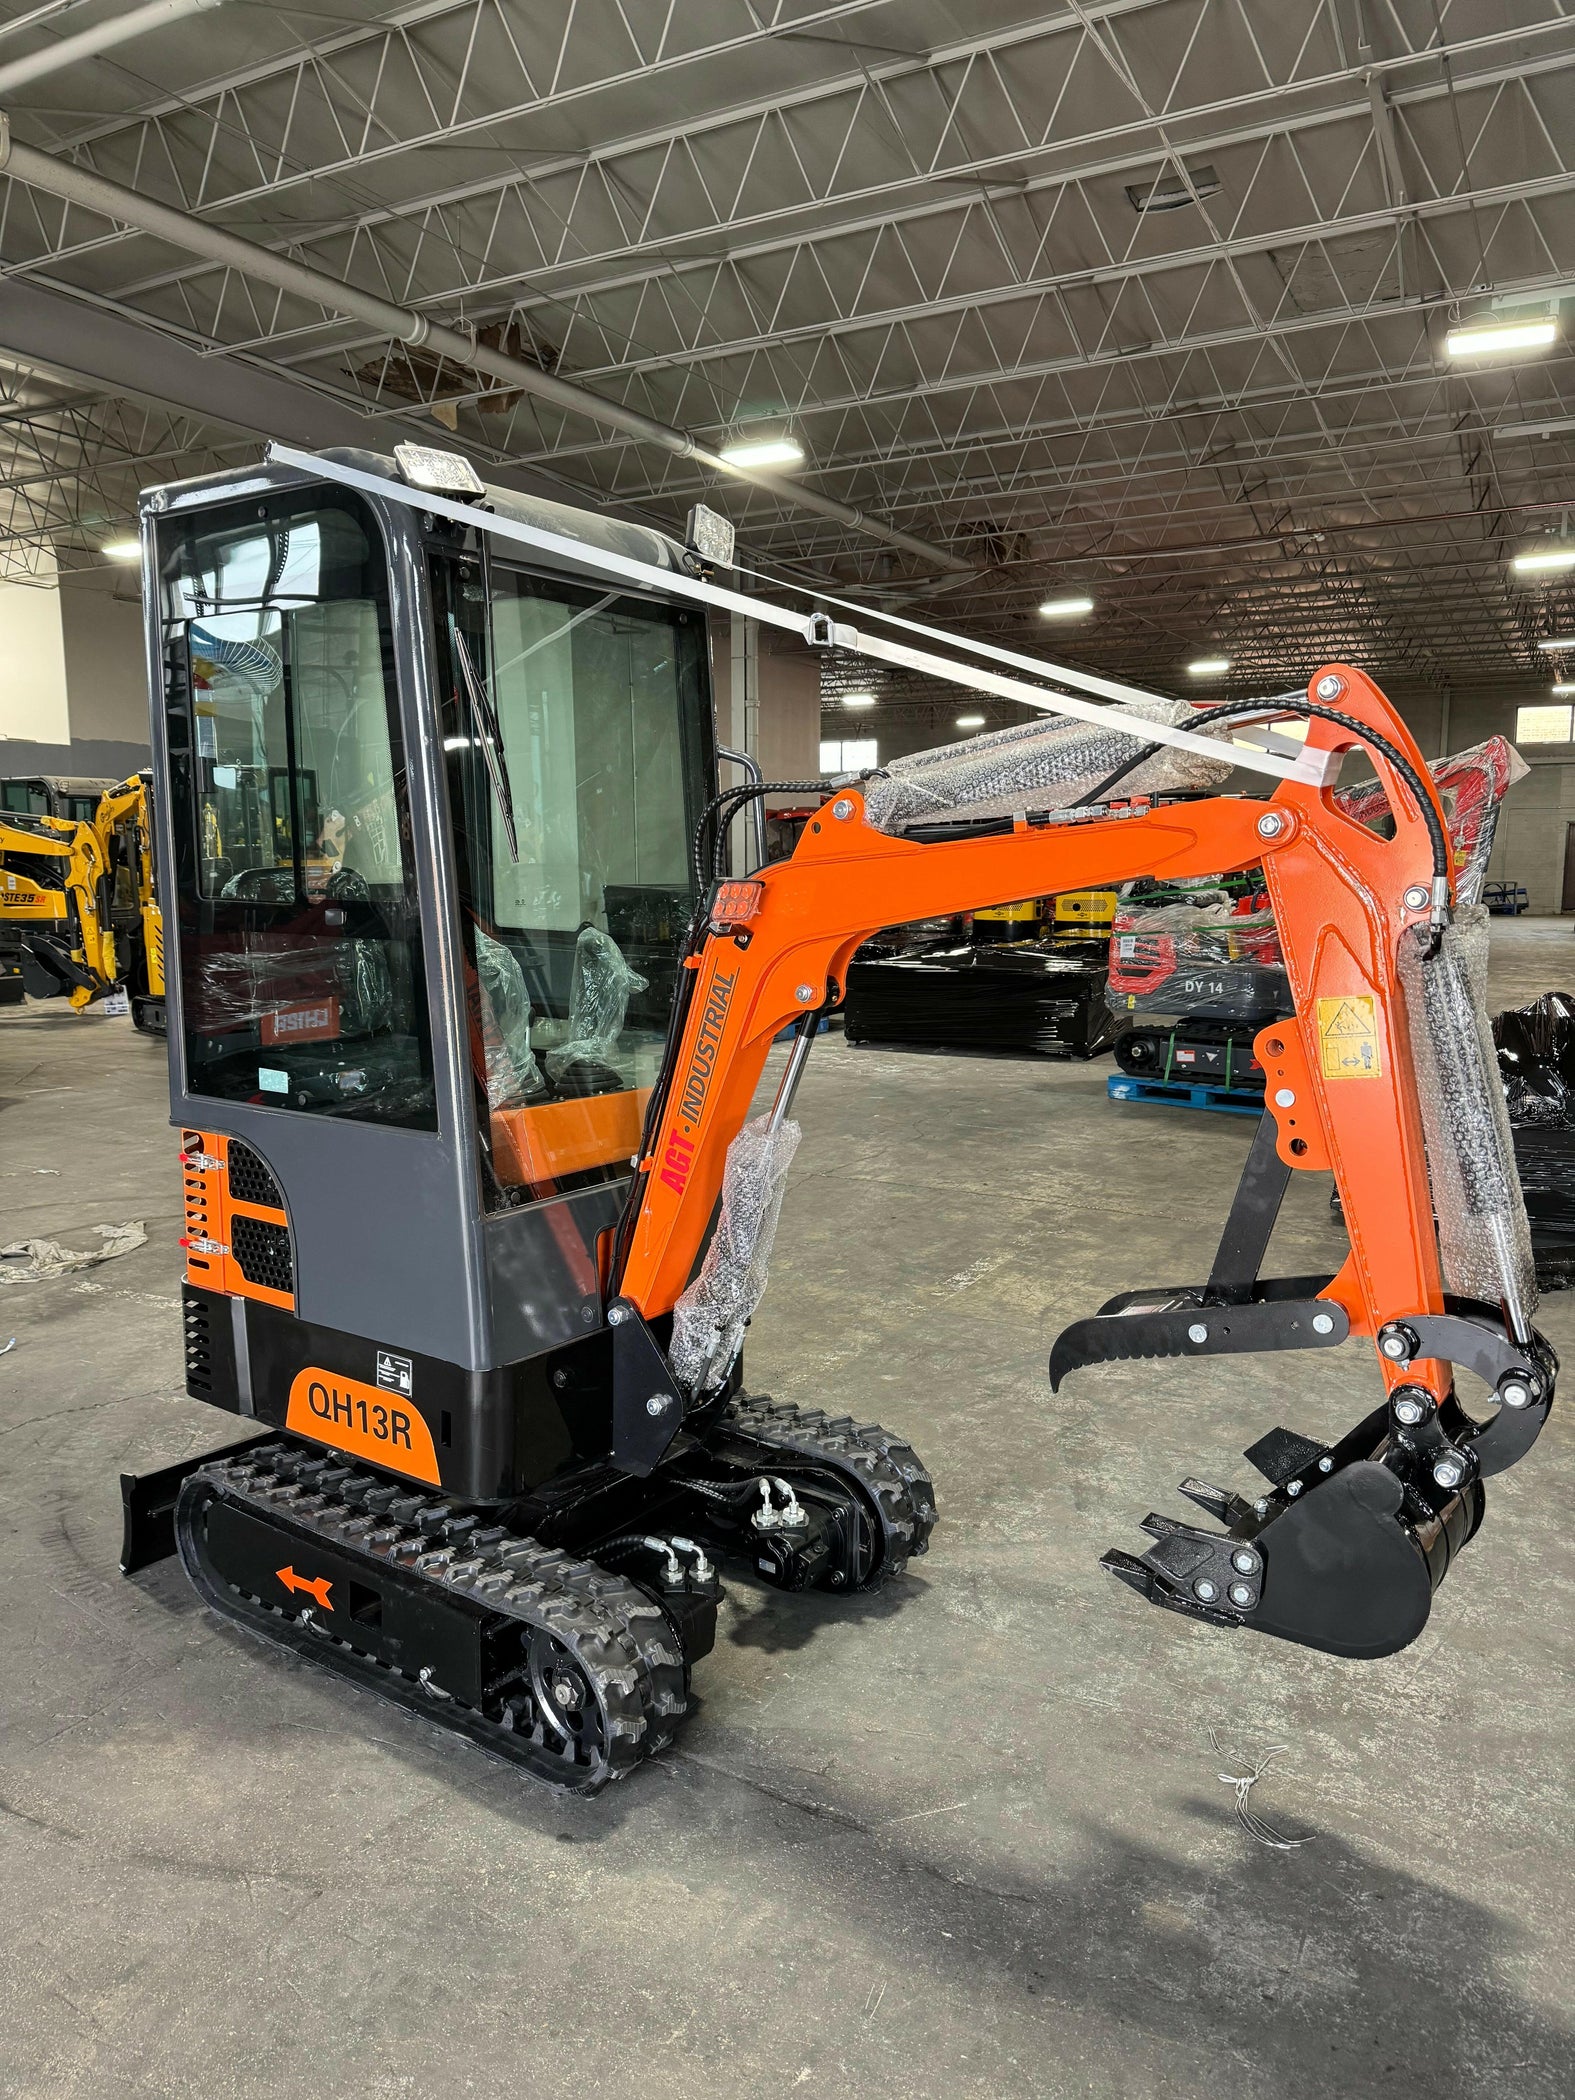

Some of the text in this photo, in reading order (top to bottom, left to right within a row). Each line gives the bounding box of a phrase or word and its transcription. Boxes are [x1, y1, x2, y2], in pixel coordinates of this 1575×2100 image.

[1185, 980, 1224, 994] DY 14
[660, 971, 735, 1196] AGT INDUSTRIAL
[308, 1381, 412, 1450] QH13R
